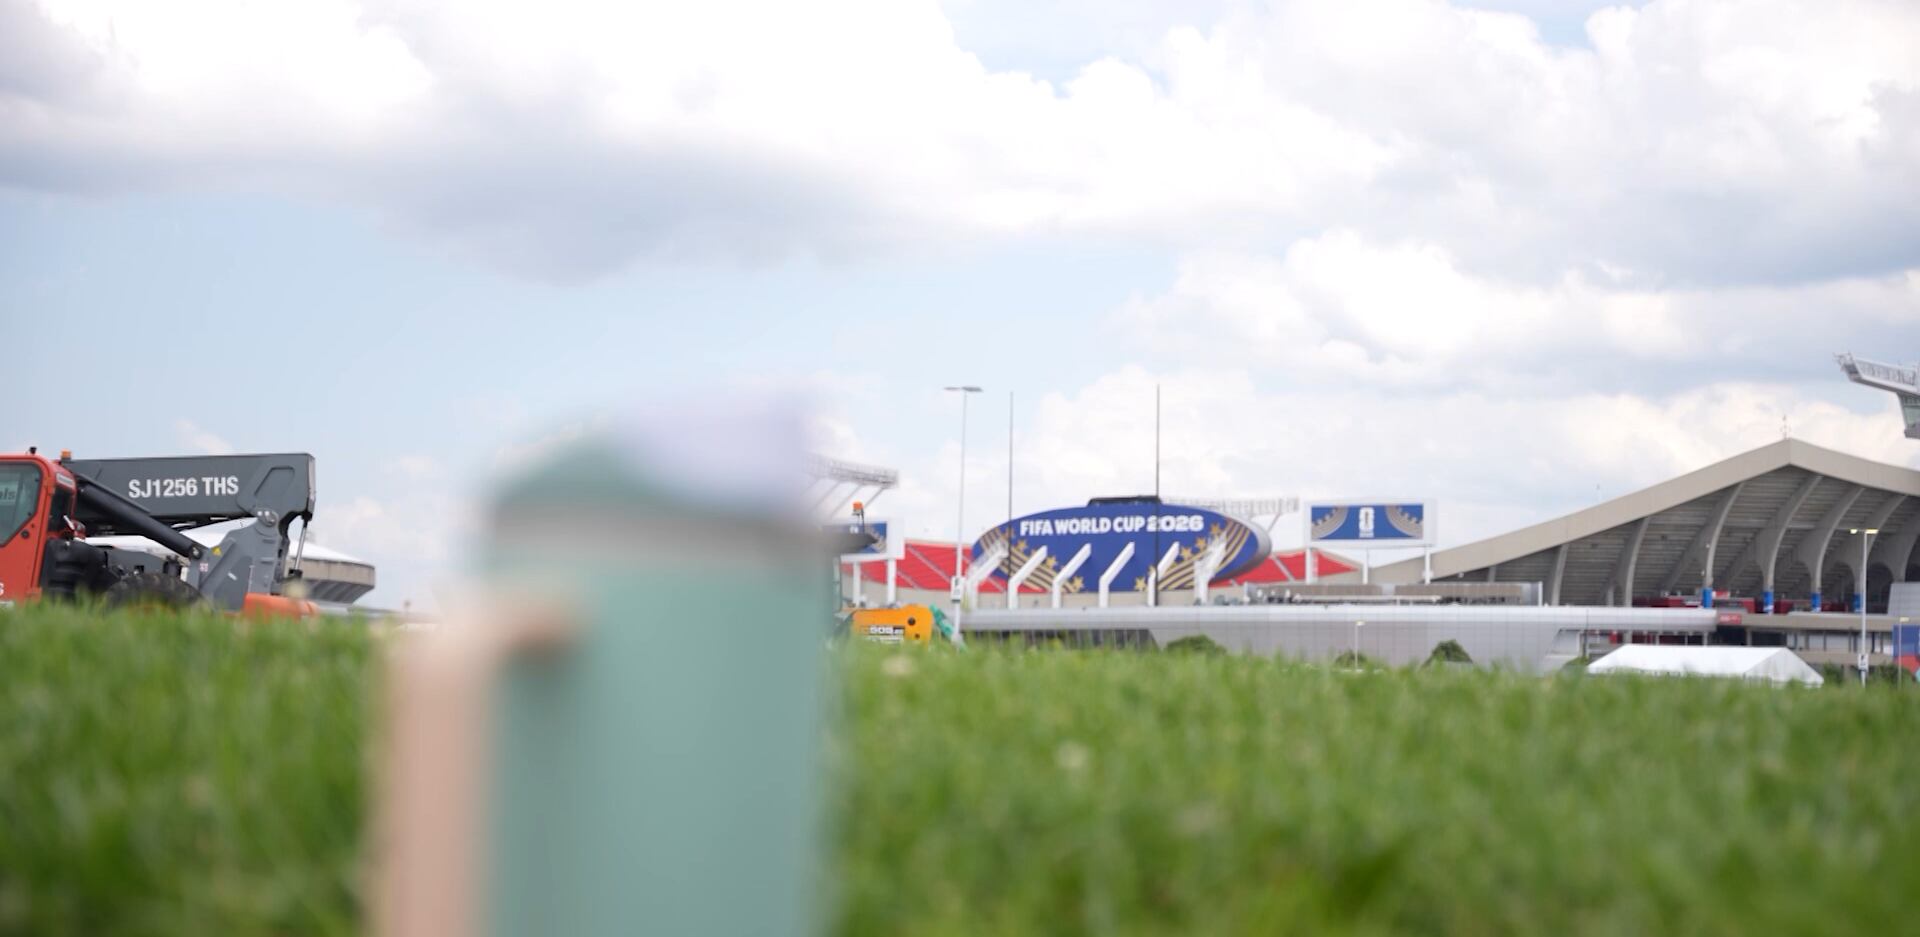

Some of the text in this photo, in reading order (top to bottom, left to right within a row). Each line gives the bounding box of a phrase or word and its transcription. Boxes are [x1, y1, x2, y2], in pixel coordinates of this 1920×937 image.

[128, 475, 239, 498] SJ1256 THS
[1020, 515, 1204, 536] FIFA WORLD CUP 2026
